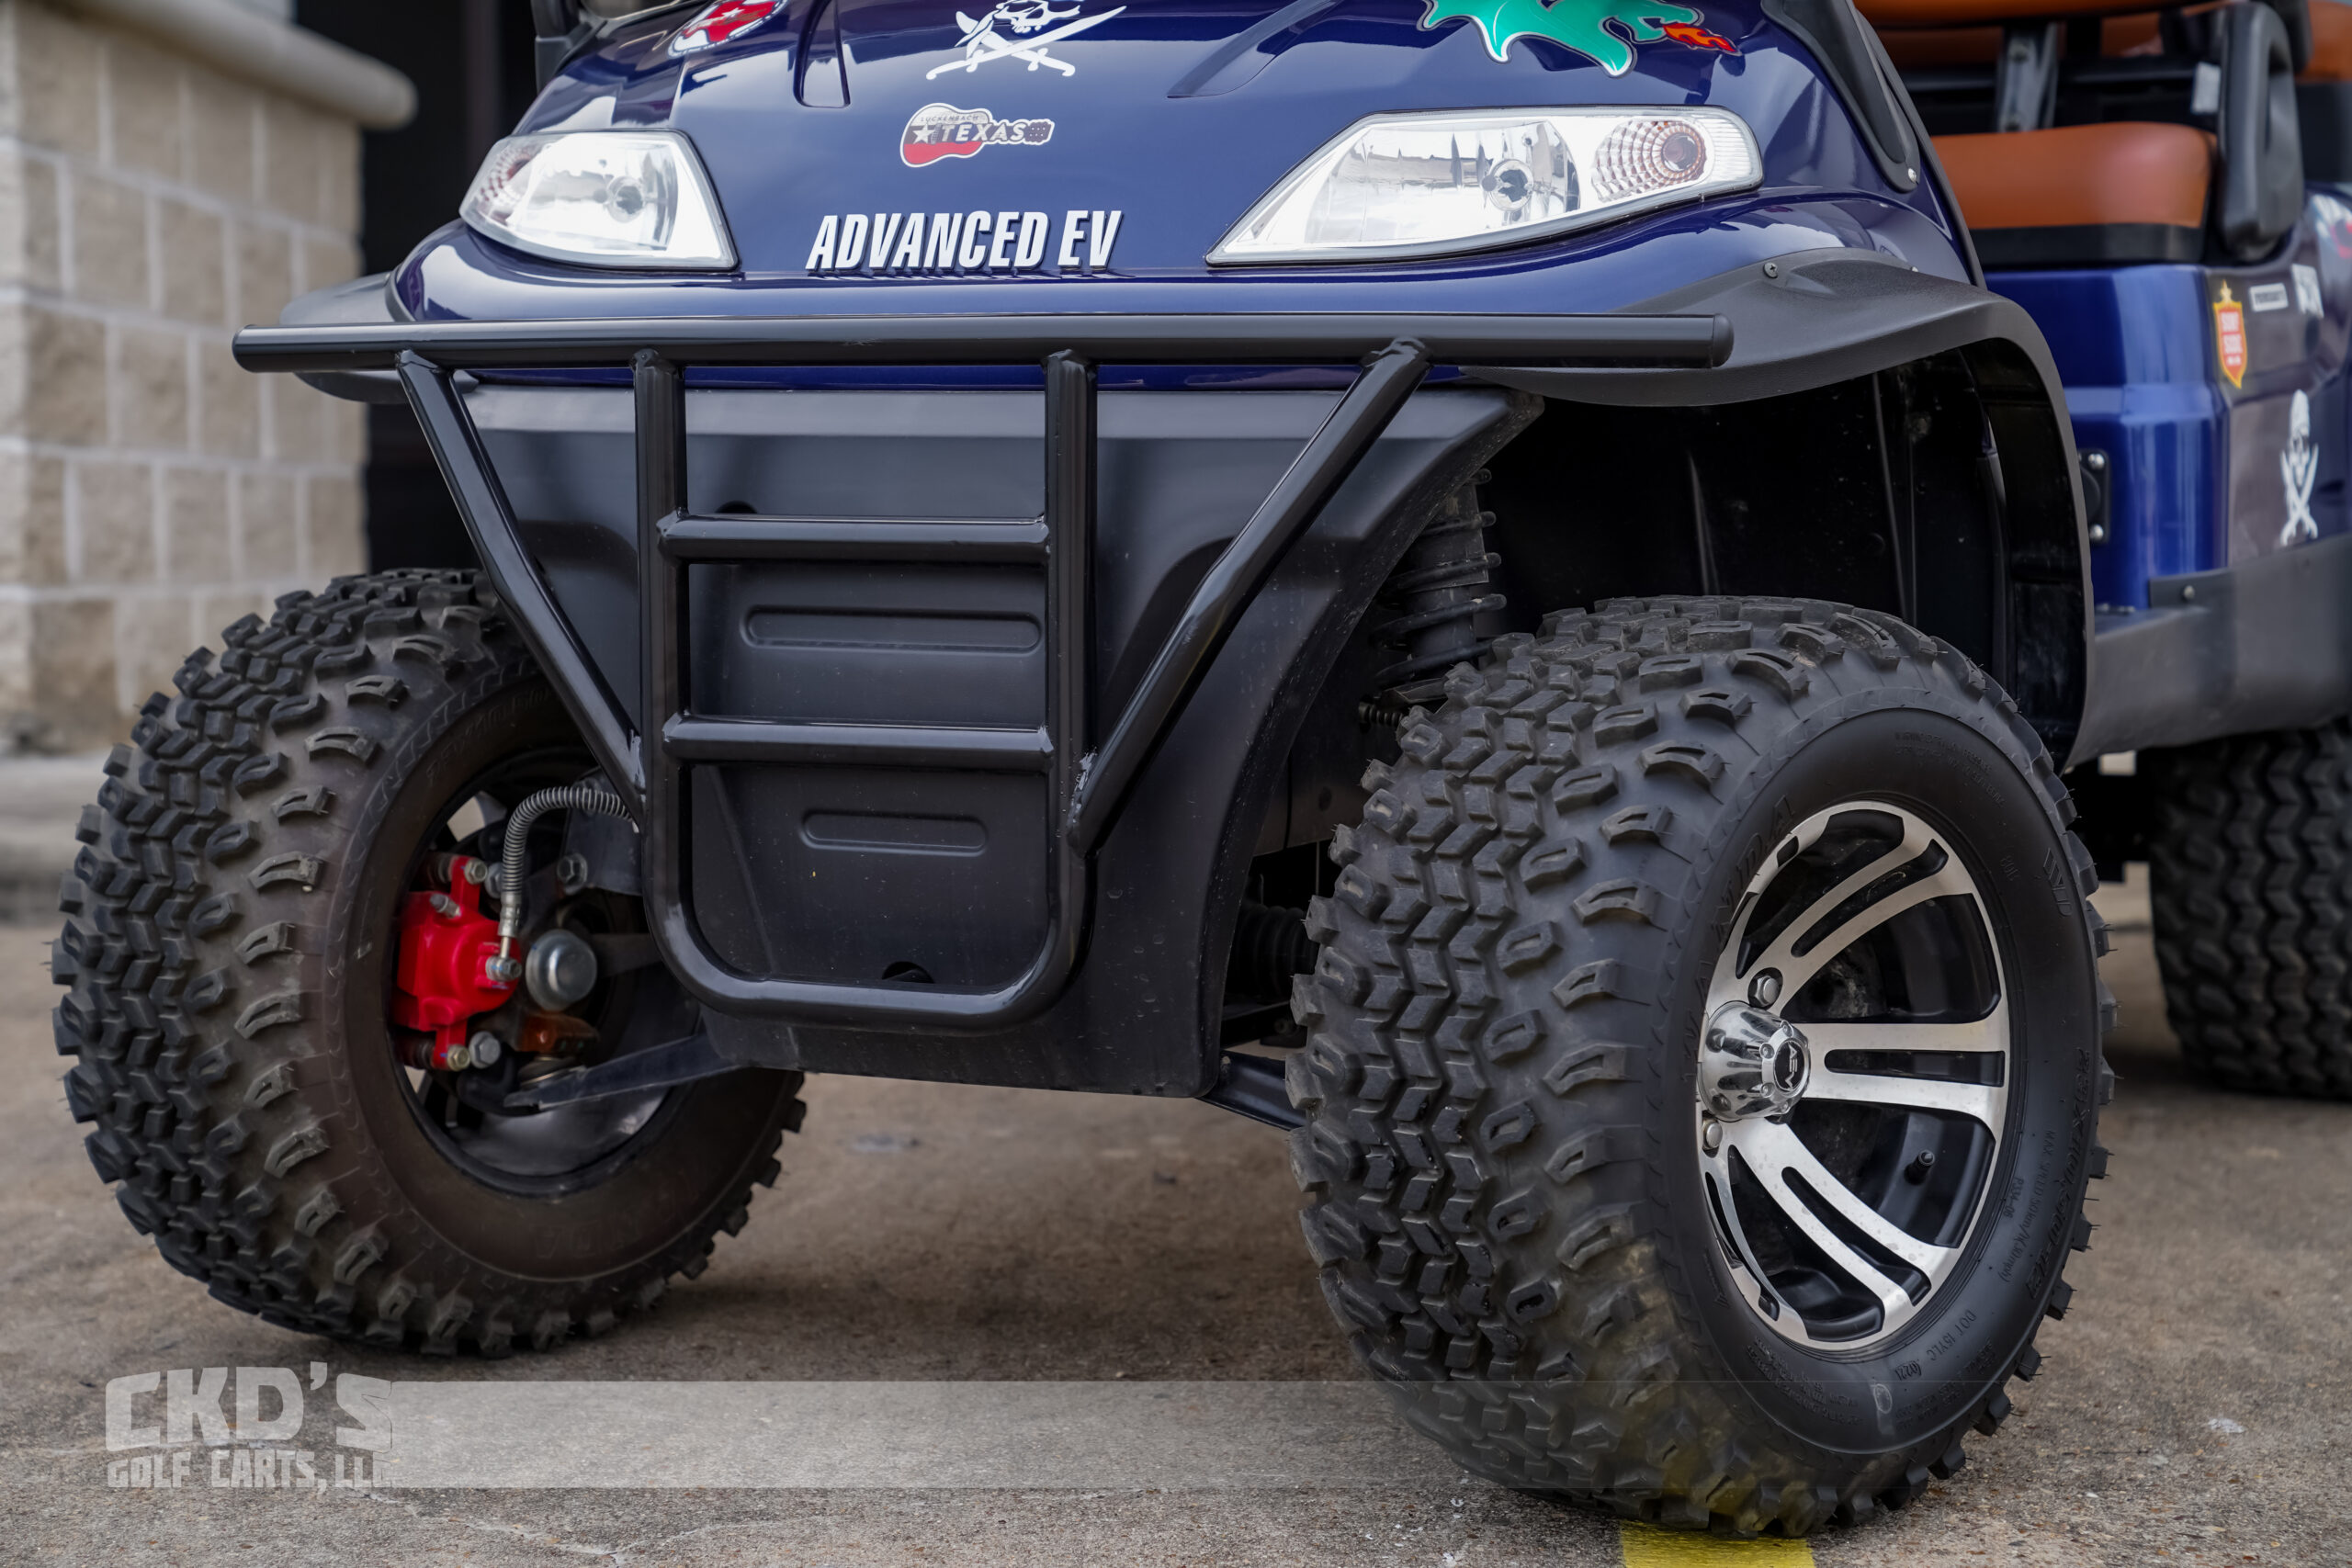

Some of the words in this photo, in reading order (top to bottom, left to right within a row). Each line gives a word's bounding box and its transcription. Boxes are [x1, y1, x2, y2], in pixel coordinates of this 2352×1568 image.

[941, 123, 1027, 141] TEXAS
[805, 210, 1050, 272] ADVANCED
[1057, 210, 1123, 270] EV
[1955, 1309, 1977, 1337] DOT
